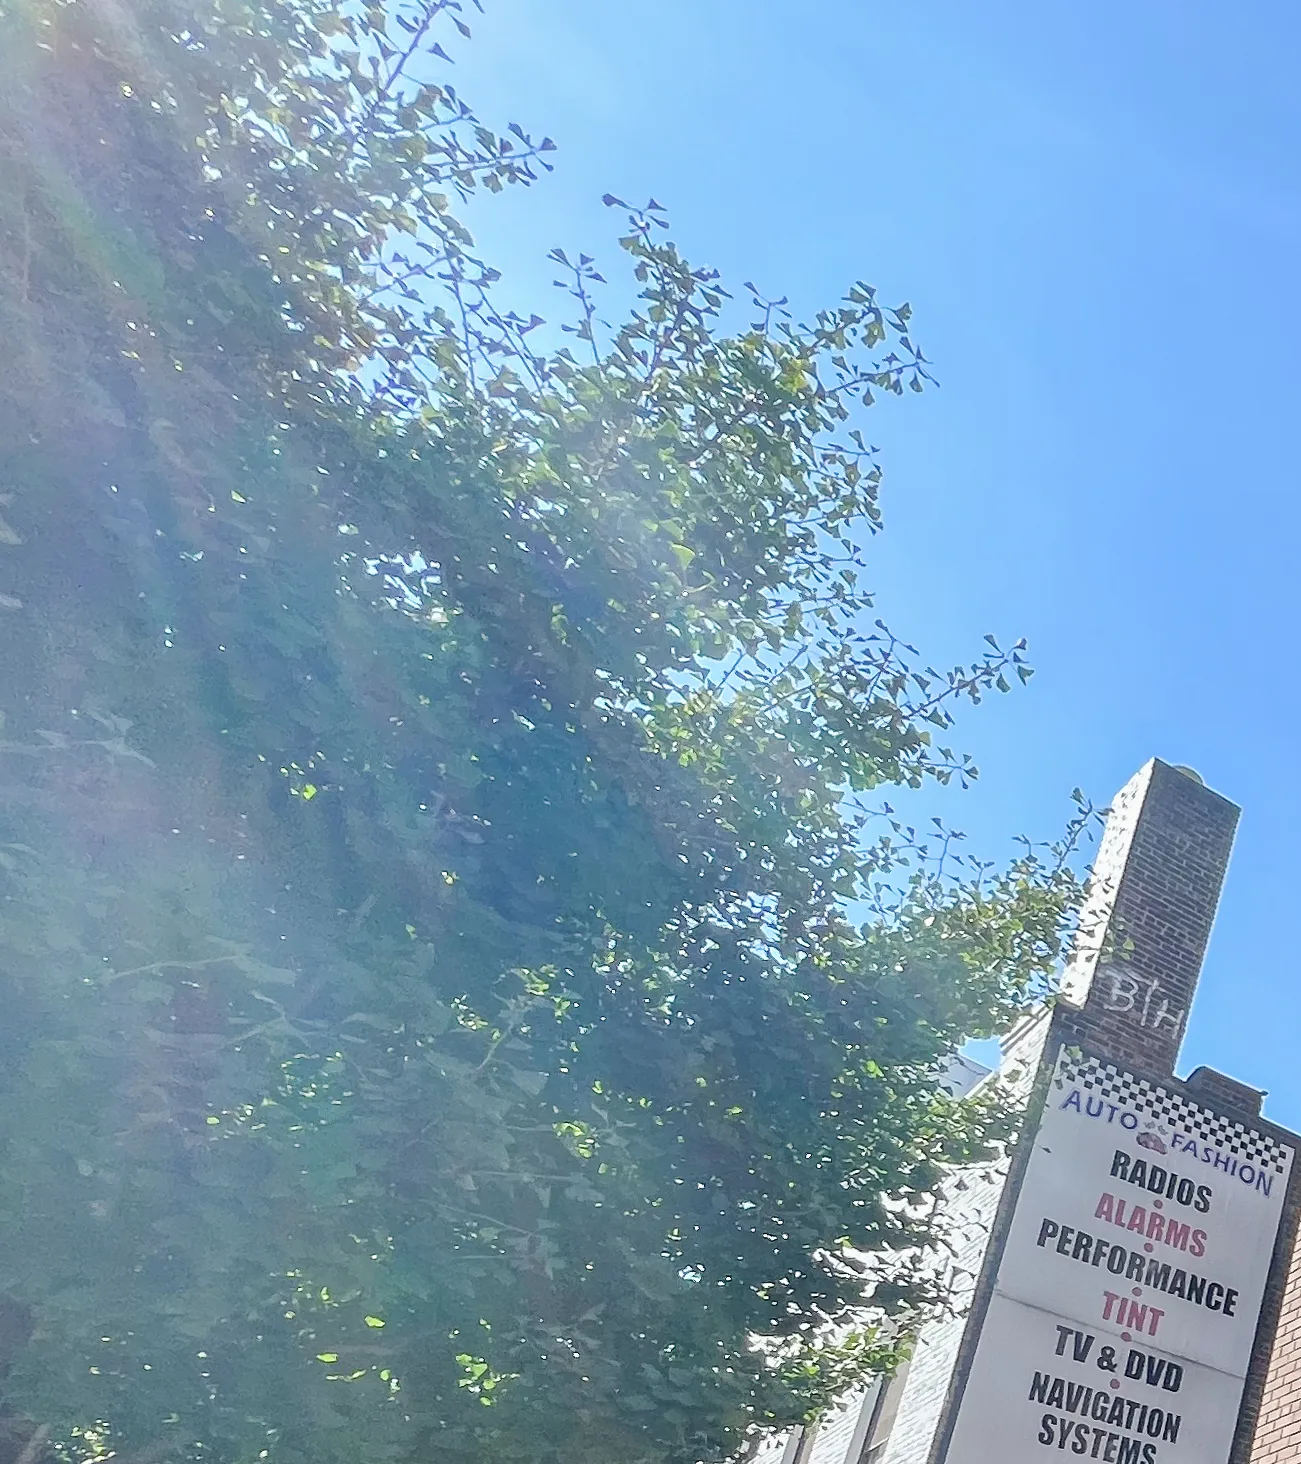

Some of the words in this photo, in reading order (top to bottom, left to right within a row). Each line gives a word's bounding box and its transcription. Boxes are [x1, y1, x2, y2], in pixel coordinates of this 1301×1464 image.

[1059, 1090, 1138, 1130] AUTO
[1171, 1132, 1275, 1197] FASHION
[1109, 1149, 1213, 1213] RADIOS
[1094, 1192, 1208, 1257] ALARMS
[1036, 1218, 1240, 1317] PERFORMANCE
[1102, 1290, 1165, 1336] TINT
[1055, 1324, 1096, 1363] TV
[1096, 1345, 1118, 1373] &
[1123, 1349, 1184, 1393] DVD
[1028, 1371, 1182, 1444] NAVIGATION
